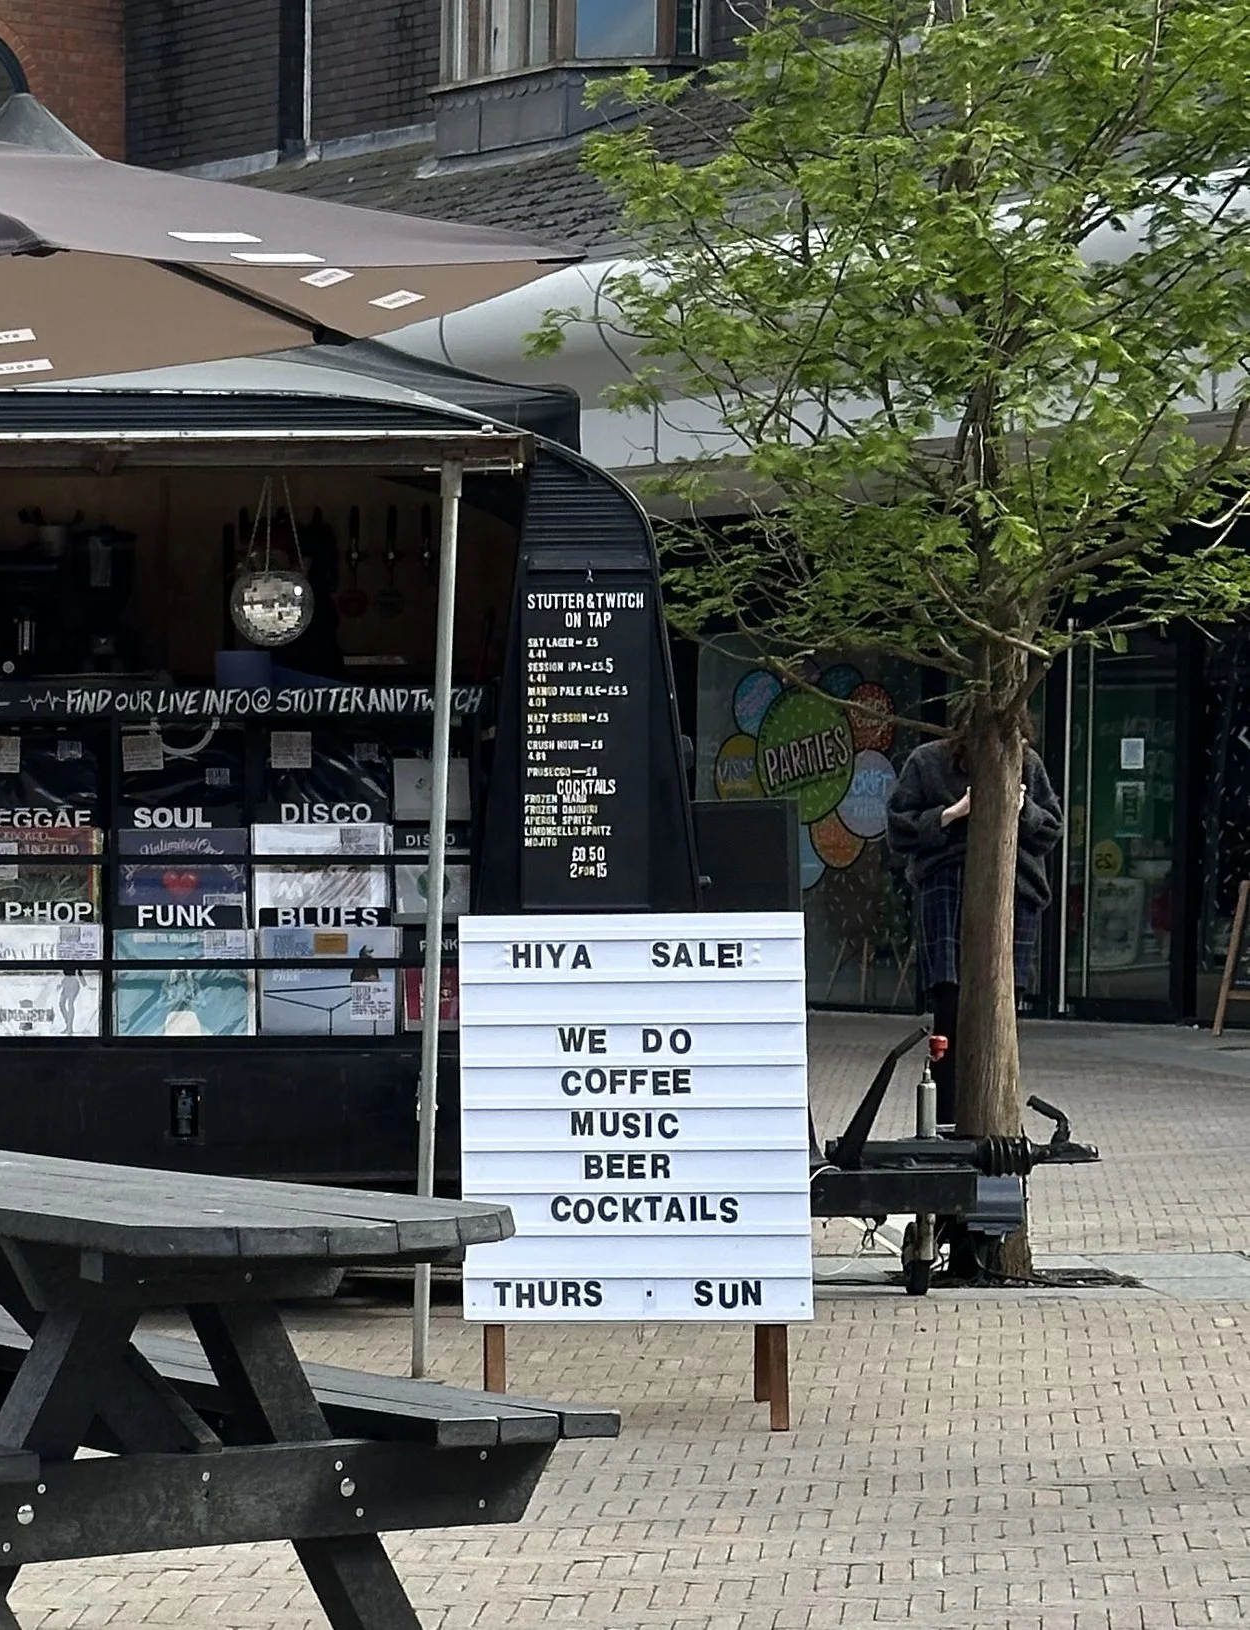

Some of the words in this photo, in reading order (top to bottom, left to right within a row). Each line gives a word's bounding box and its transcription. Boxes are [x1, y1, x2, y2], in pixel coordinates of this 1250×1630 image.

[527, 593, 644, 610] STUTTER&TWITCH
[565, 612, 582, 628] ON
[587, 612, 612, 628] TAP
[527, 662, 564, 672] SESSION
[527, 686, 558, 696] MANGO
[559, 686, 582, 696] PALE
[67, 689, 112, 714] FIND
[114, 690, 154, 713] OUR
[157, 689, 200, 715] LIVE
[527, 713, 550, 723] HAZY
[527, 740, 555, 750] CRUSH
[763, 725, 849, 788] PARTIES
[556, 779, 617, 795] COCKTAILS
[524, 794, 558, 804] FROZEN
[134, 806, 212, 829] SOUL
[280, 802, 373, 824] DISCO
[524, 805, 558, 814] FROZEN
[524, 815, 557, 825] APEROL
[562, 815, 593, 825] SPRITZ
[524, 826, 579, 836] LIMONCELLO
[580, 826, 612, 836] SPRITZ
[405, 833, 456, 848] DISO
[524, 837, 558, 847] MOJITO
[137, 904, 216, 927] FUNK
[277, 907, 379, 927] BLUES
[512, 943, 592, 969] HIYA
[651, 942, 743, 969] SALE!
[557, 1027, 607, 1054] WE
[642, 1028, 692, 1054] DO
[561, 1068, 691, 1096] COFFEE
[570, 1111, 679, 1139] MUSIC
[584, 1154, 671, 1180] BEER
[550, 1195, 739, 1224] COCKTAILS
[493, 1281, 603, 1308] THURS
[693, 1280, 762, 1309] SUN
